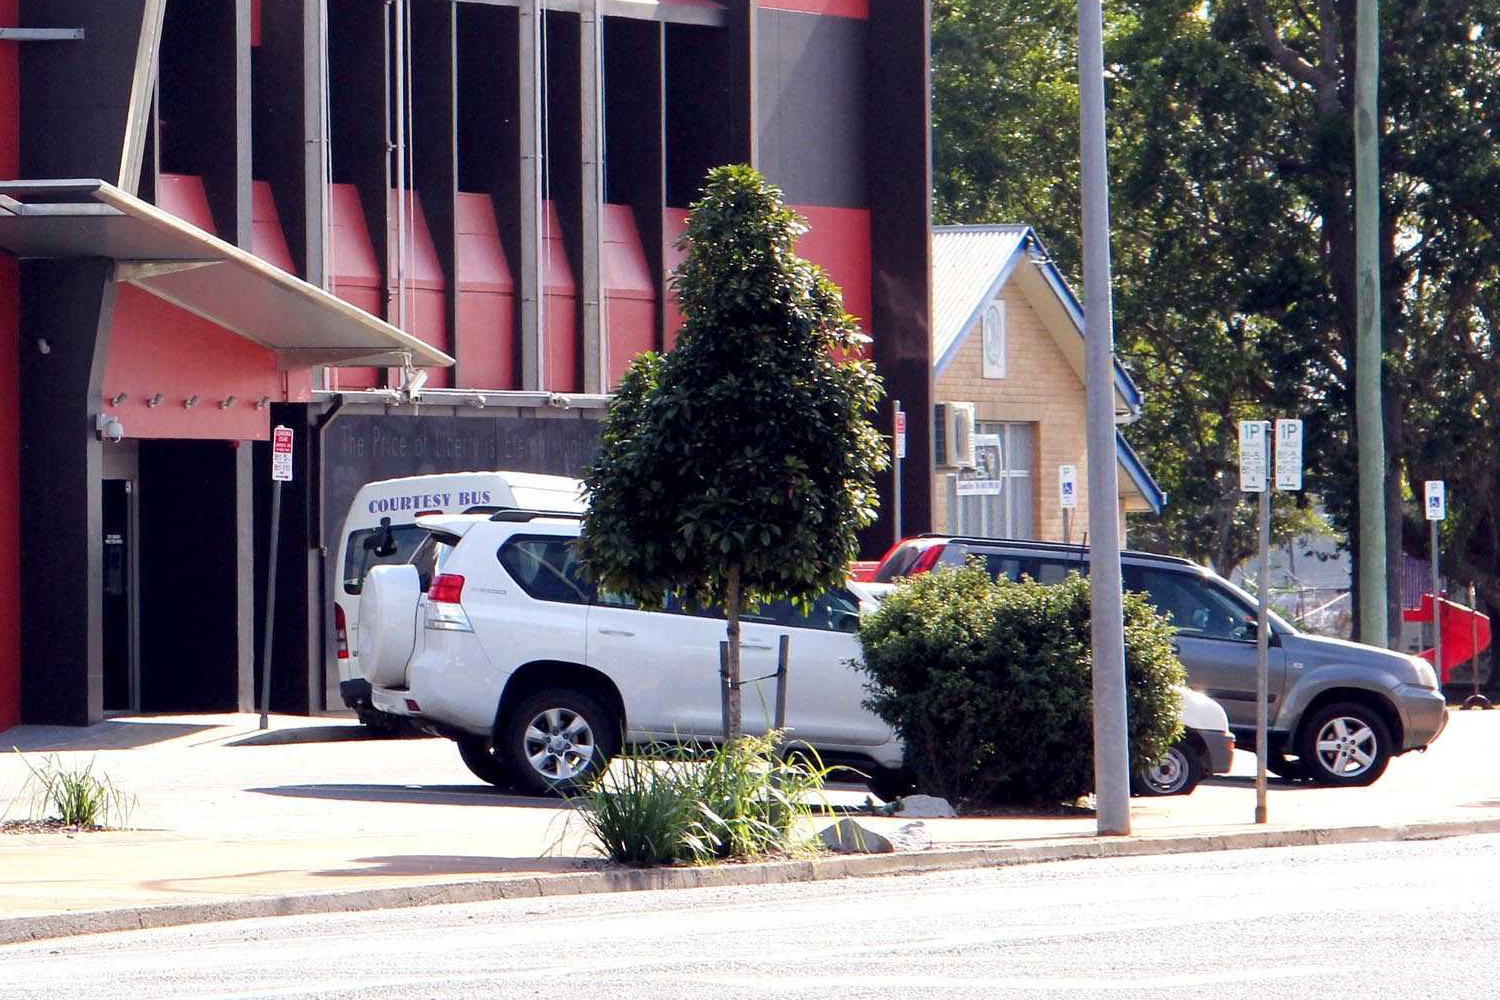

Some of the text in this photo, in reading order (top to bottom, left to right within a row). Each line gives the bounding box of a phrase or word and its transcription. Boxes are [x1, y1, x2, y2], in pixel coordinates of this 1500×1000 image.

[1244, 423, 1260, 440] 1P
[1281, 423, 1297, 440] 1P
[368, 491, 491, 513] COURTESY BUS
